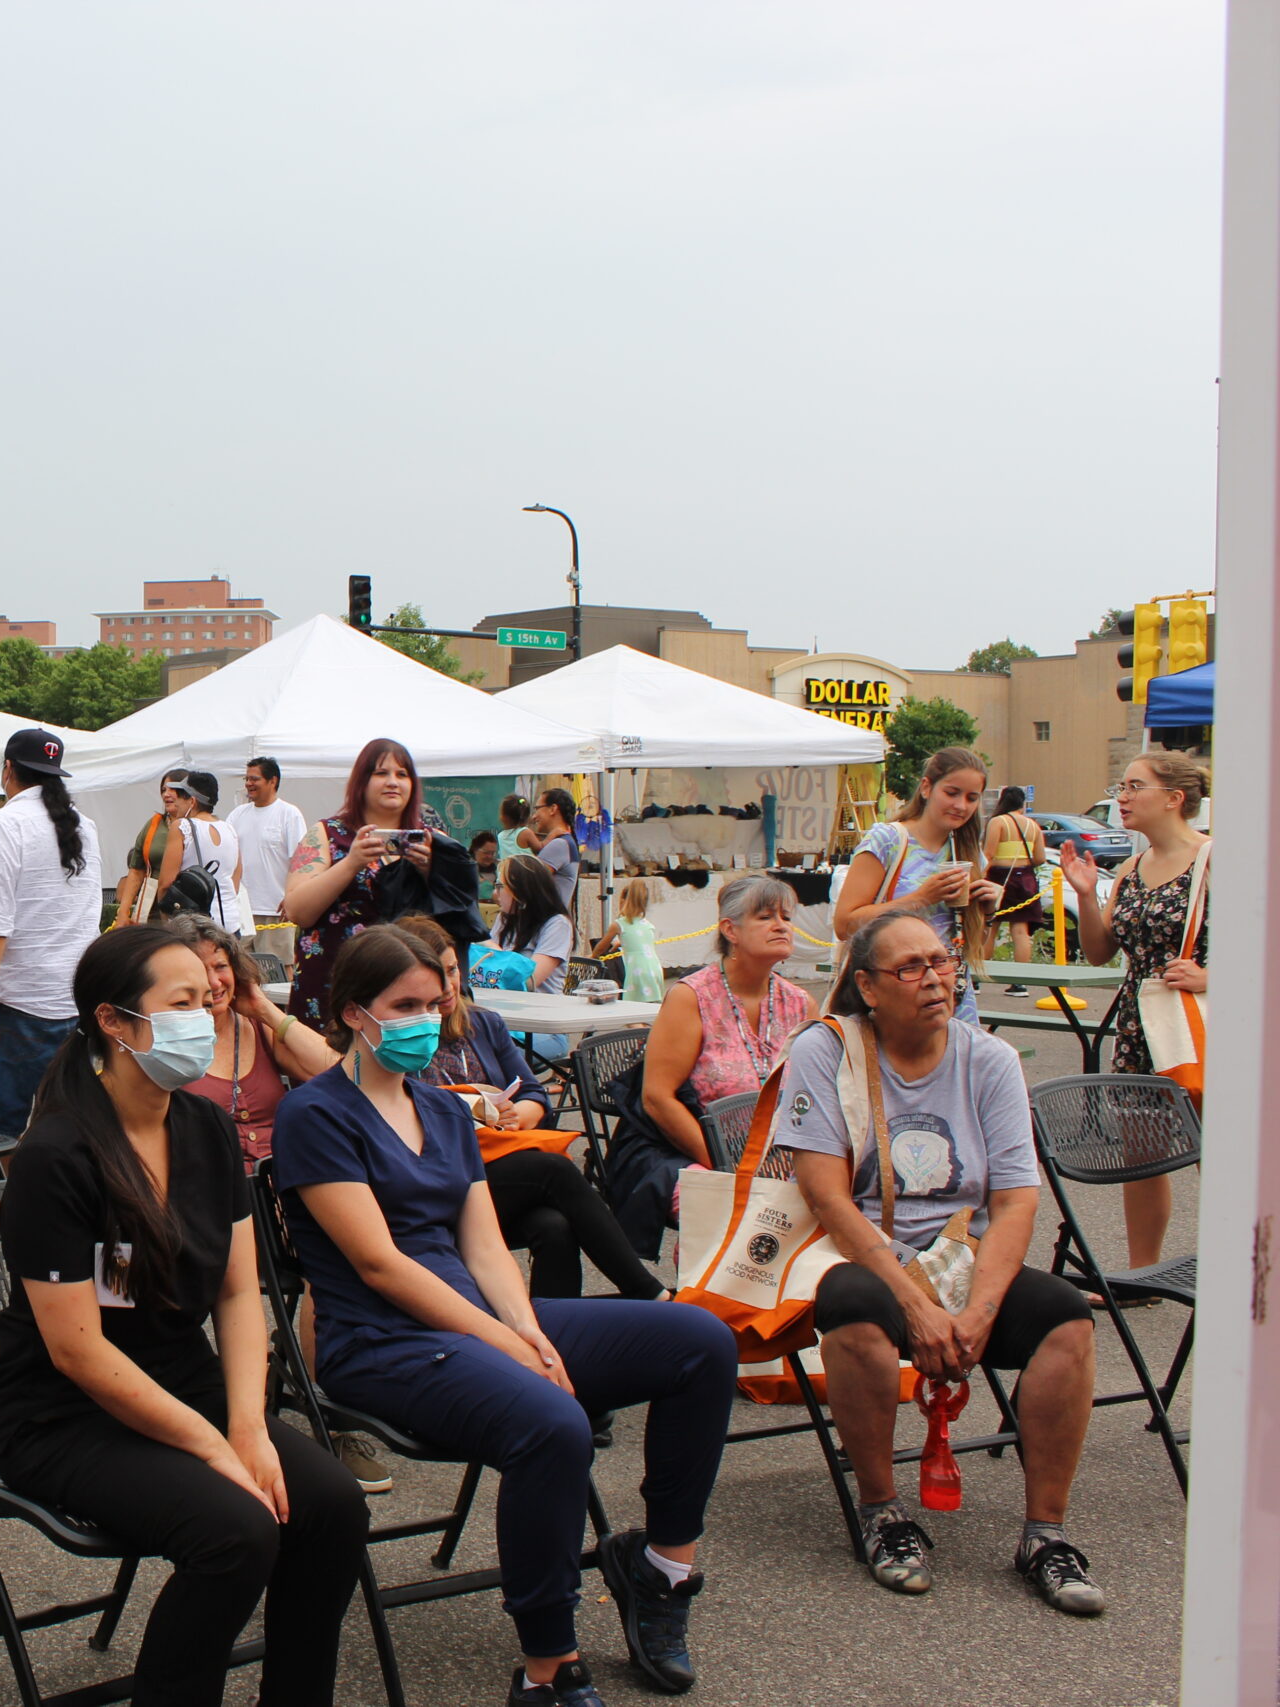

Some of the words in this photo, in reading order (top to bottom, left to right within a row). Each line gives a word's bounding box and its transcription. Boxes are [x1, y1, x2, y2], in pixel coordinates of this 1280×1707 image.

[506, 632, 513, 642] S
[518, 633, 539, 644] 15th
[544, 635, 558, 645] Av
[807, 679, 892, 705] DOLLAR
[757, 1212, 793, 1229] SISTERS
[764, 1207, 788, 1220] FOUR
[725, 1266, 745, 1278] FOOD
[746, 1273, 778, 1287] NETWORK
[734, 1262, 774, 1280] INDIGENOUS
